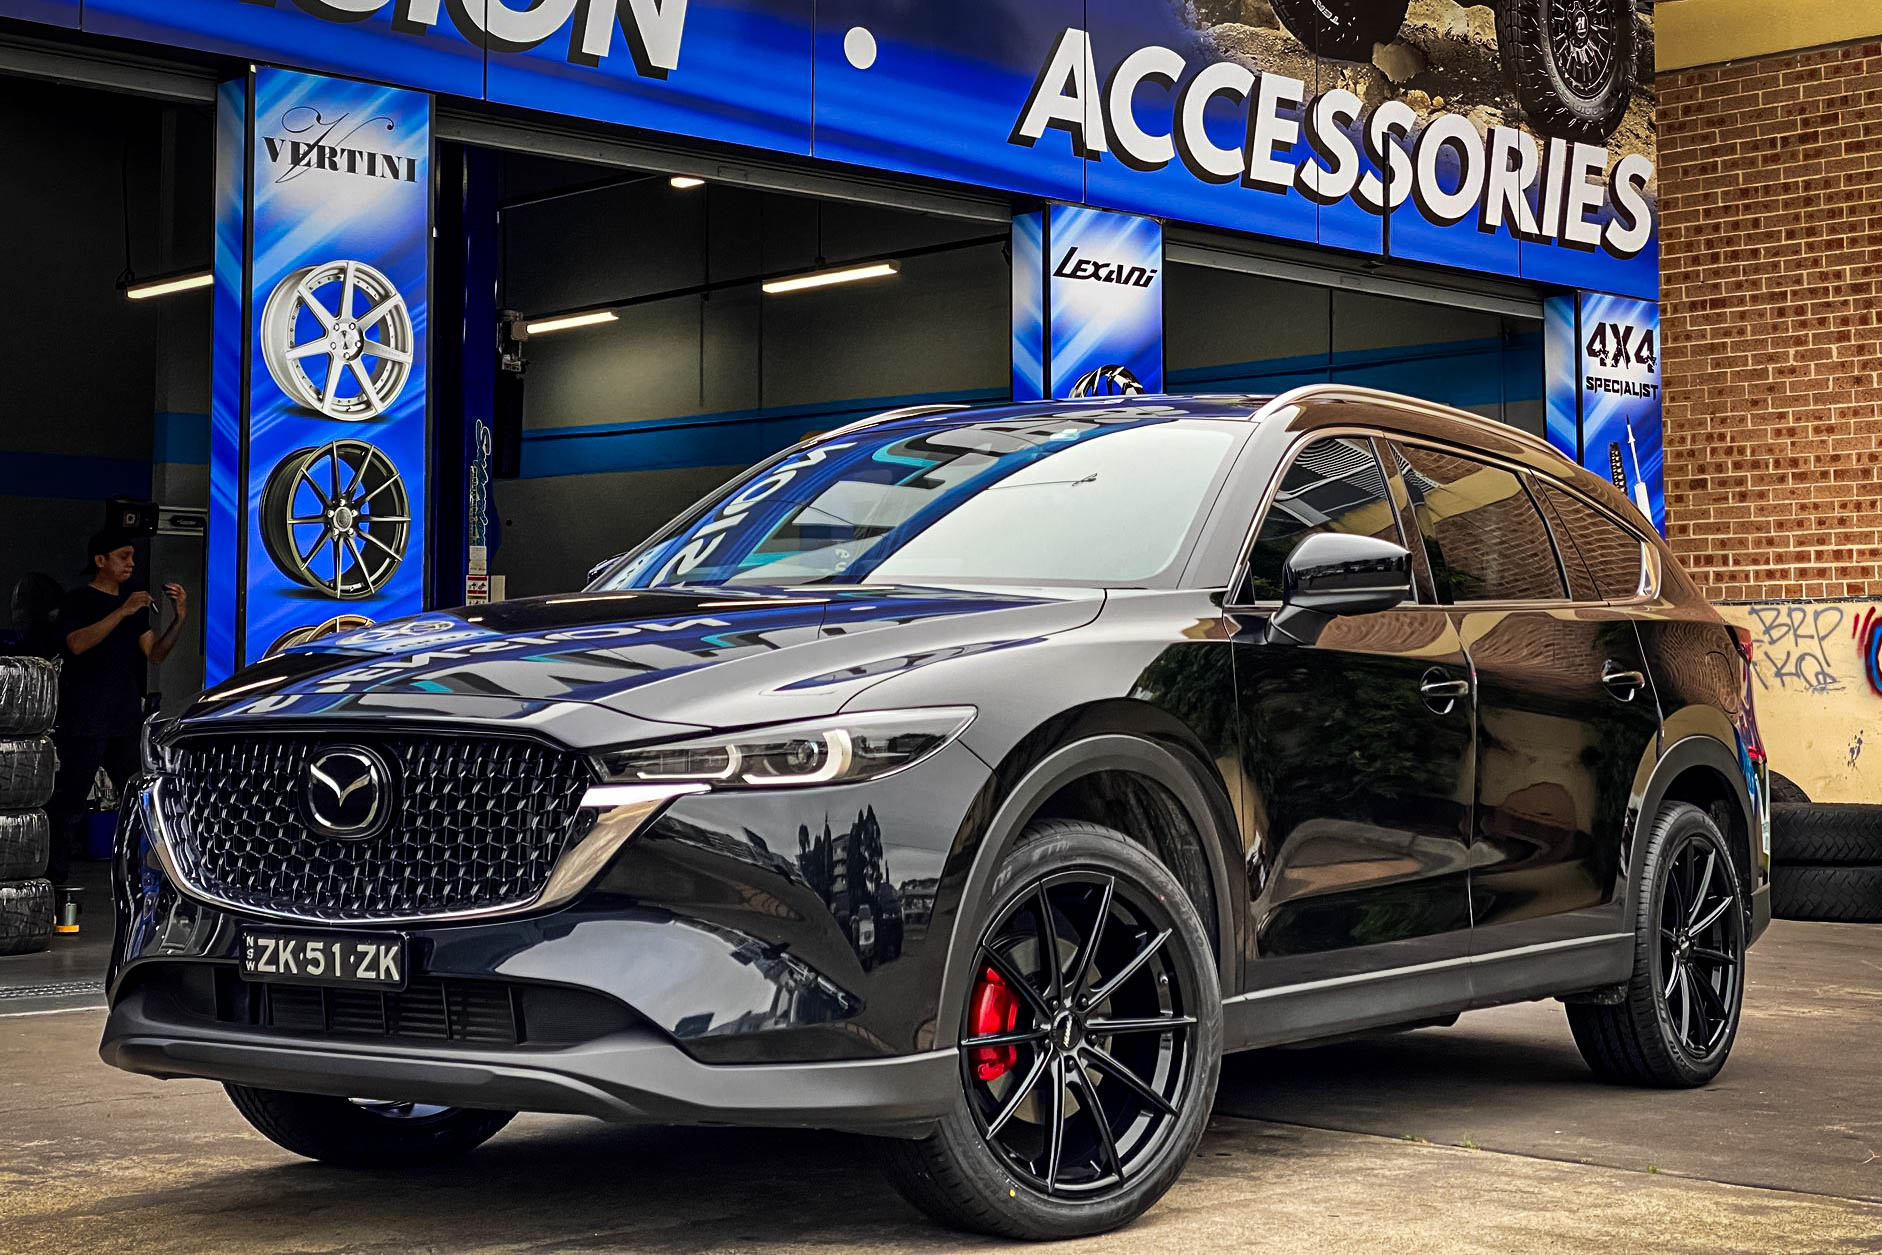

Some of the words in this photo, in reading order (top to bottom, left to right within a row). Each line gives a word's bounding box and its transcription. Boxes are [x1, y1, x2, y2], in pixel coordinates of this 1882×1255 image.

[262, 136, 418, 183] VERTINI
[1014, 27, 1654, 255] ACCESSORIES
[1586, 322, 1657, 373] 4X4
[1586, 376, 1659, 401] SPECIALIST
[245, 935, 255, 972] NSW
